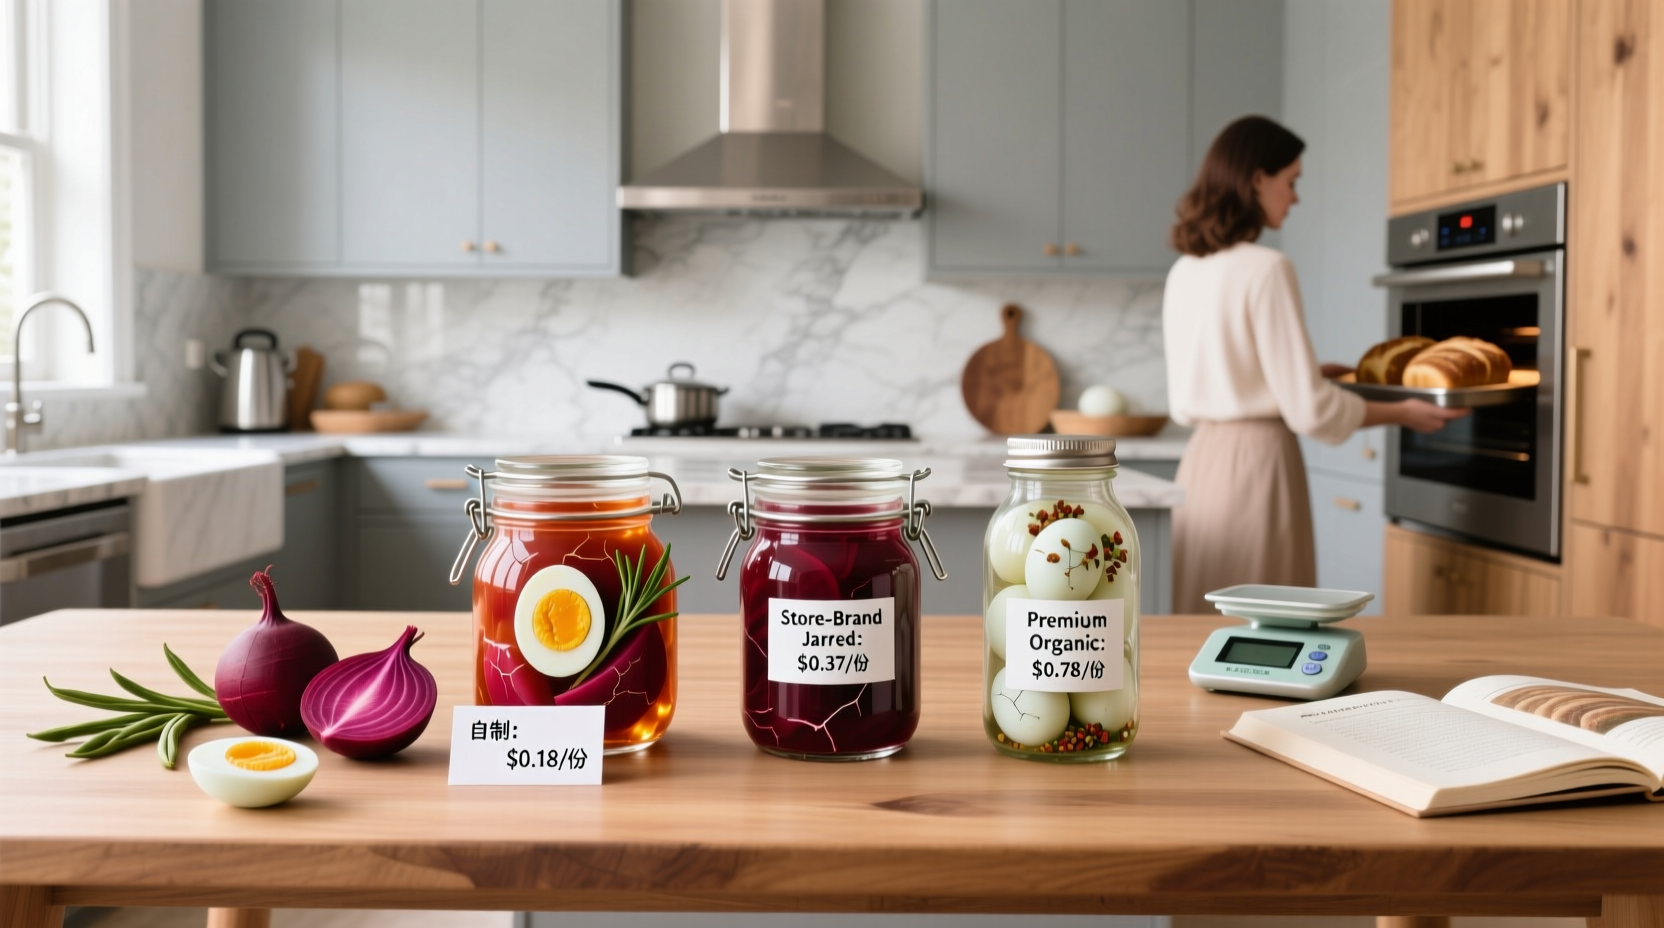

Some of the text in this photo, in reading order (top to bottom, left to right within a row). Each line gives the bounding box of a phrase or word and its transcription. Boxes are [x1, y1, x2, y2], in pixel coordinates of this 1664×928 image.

[781, 608, 883, 626] Store-Brand
[1027, 611, 1107, 629] Premium
[802, 630, 863, 647] Jarred:
[1029, 634, 1105, 656] Organic:
[797, 653, 870, 674] $0.37/份
[506, 747, 588, 771] $0.18/份
